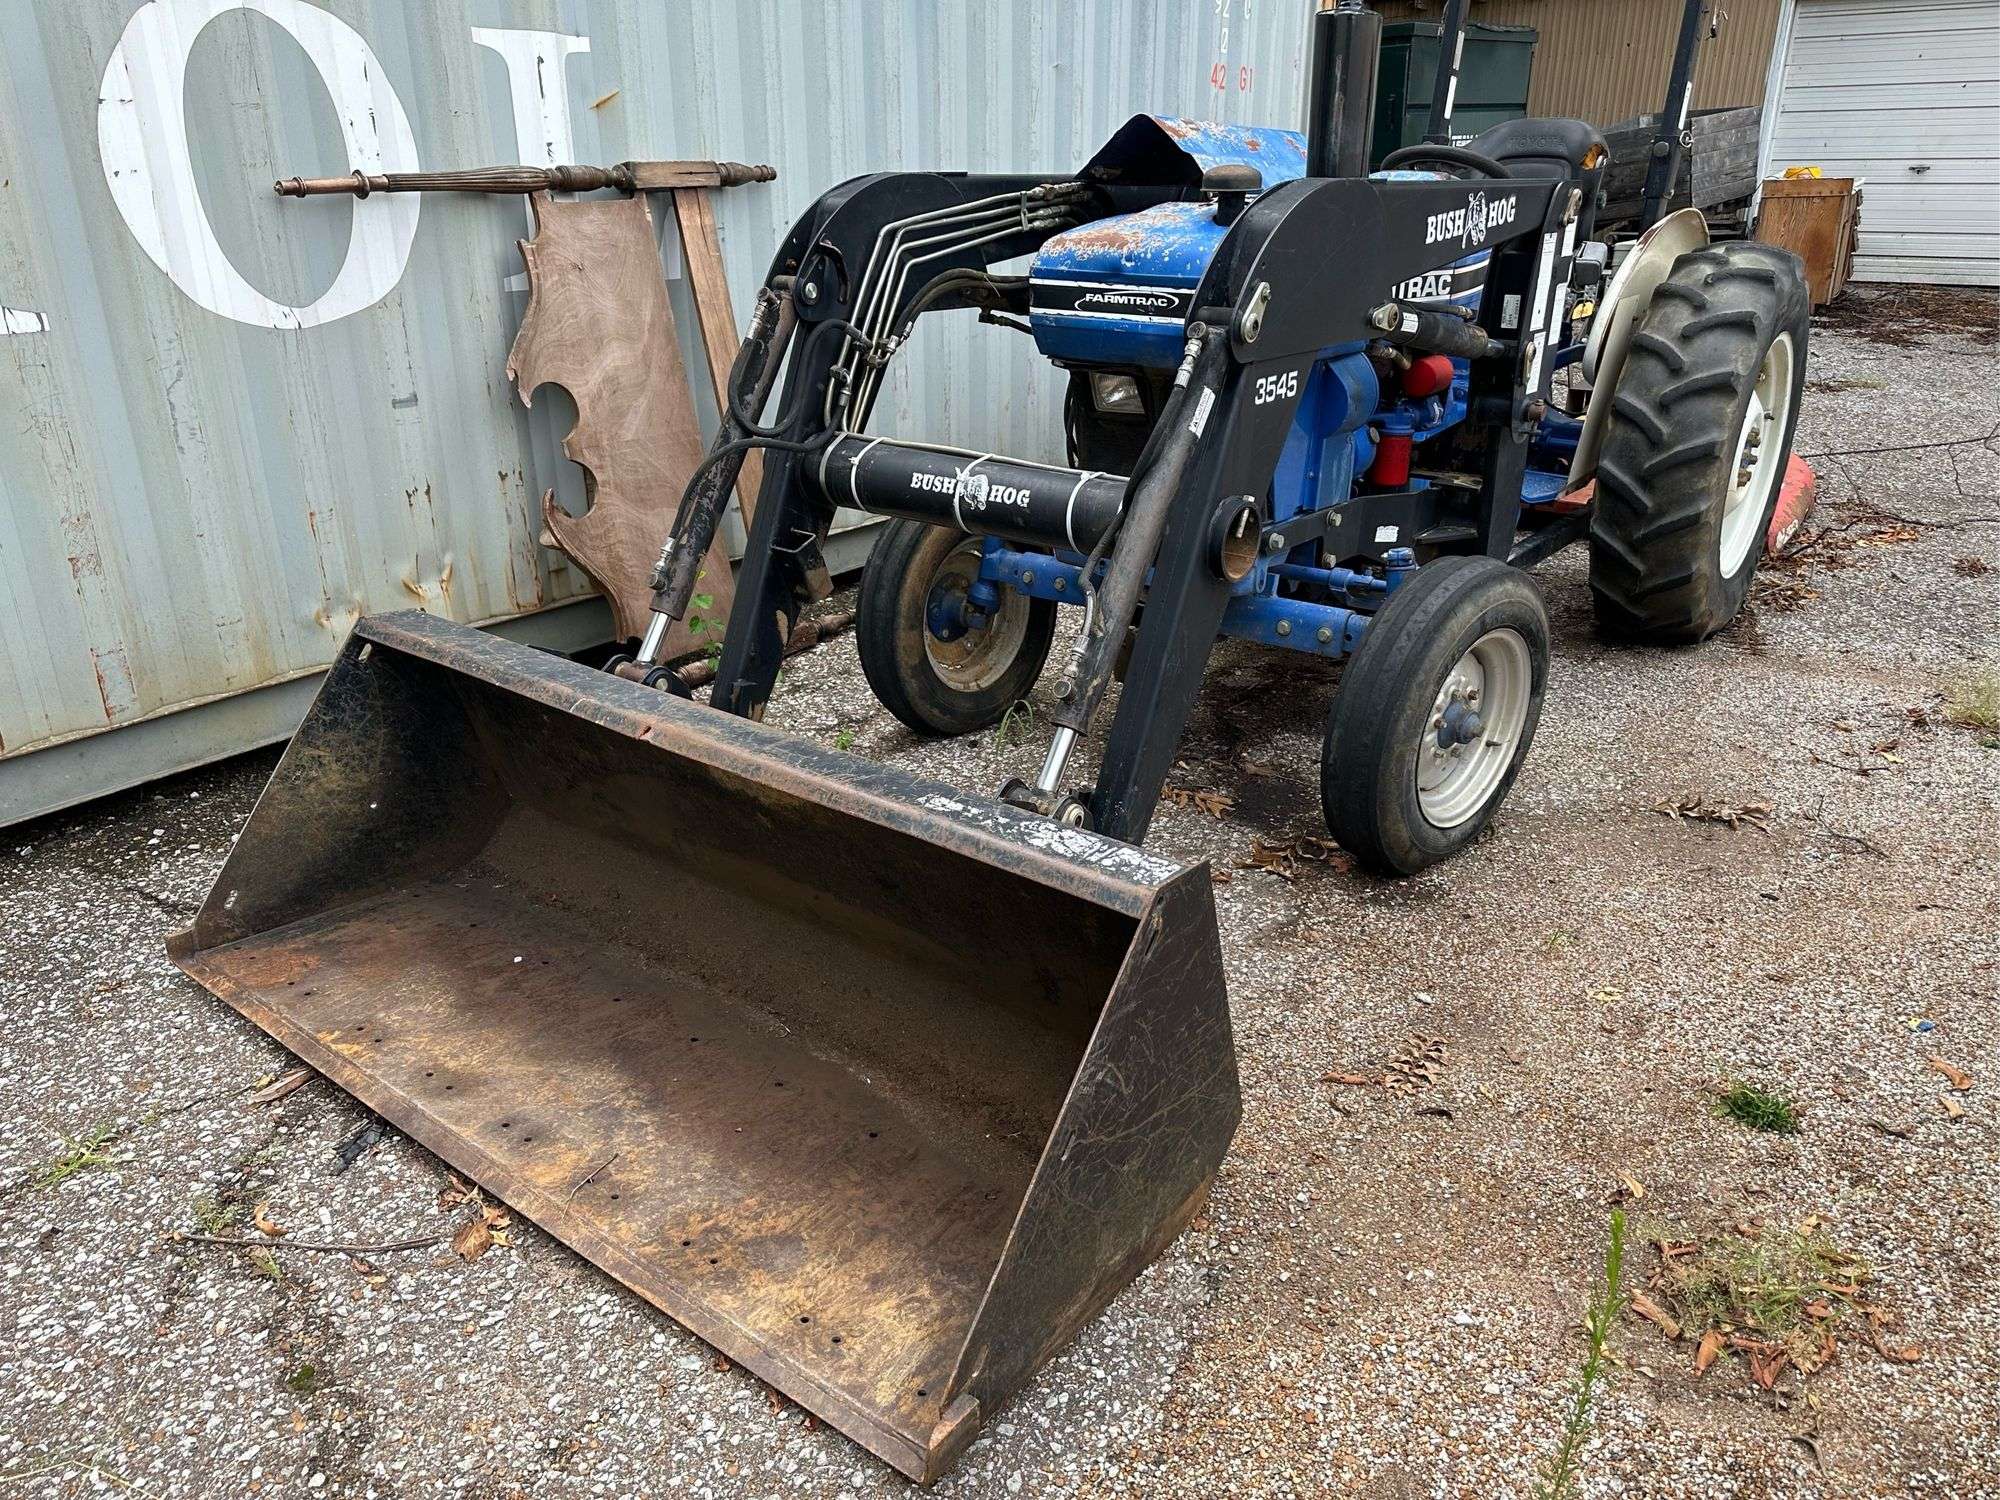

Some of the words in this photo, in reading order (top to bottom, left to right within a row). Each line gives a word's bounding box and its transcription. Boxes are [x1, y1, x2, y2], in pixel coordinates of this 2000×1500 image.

[1210, 63, 1227, 90] 42
[1425, 208, 1467, 245] BUSH
[1486, 196, 1517, 228] HOG
[1085, 292, 1168, 307] FARMTRAC
[1391, 274, 1453, 299] TRAC
[1254, 370, 1299, 405] 3545
[910, 472, 957, 495] BUSH
[988, 484, 1031, 508] HOG
